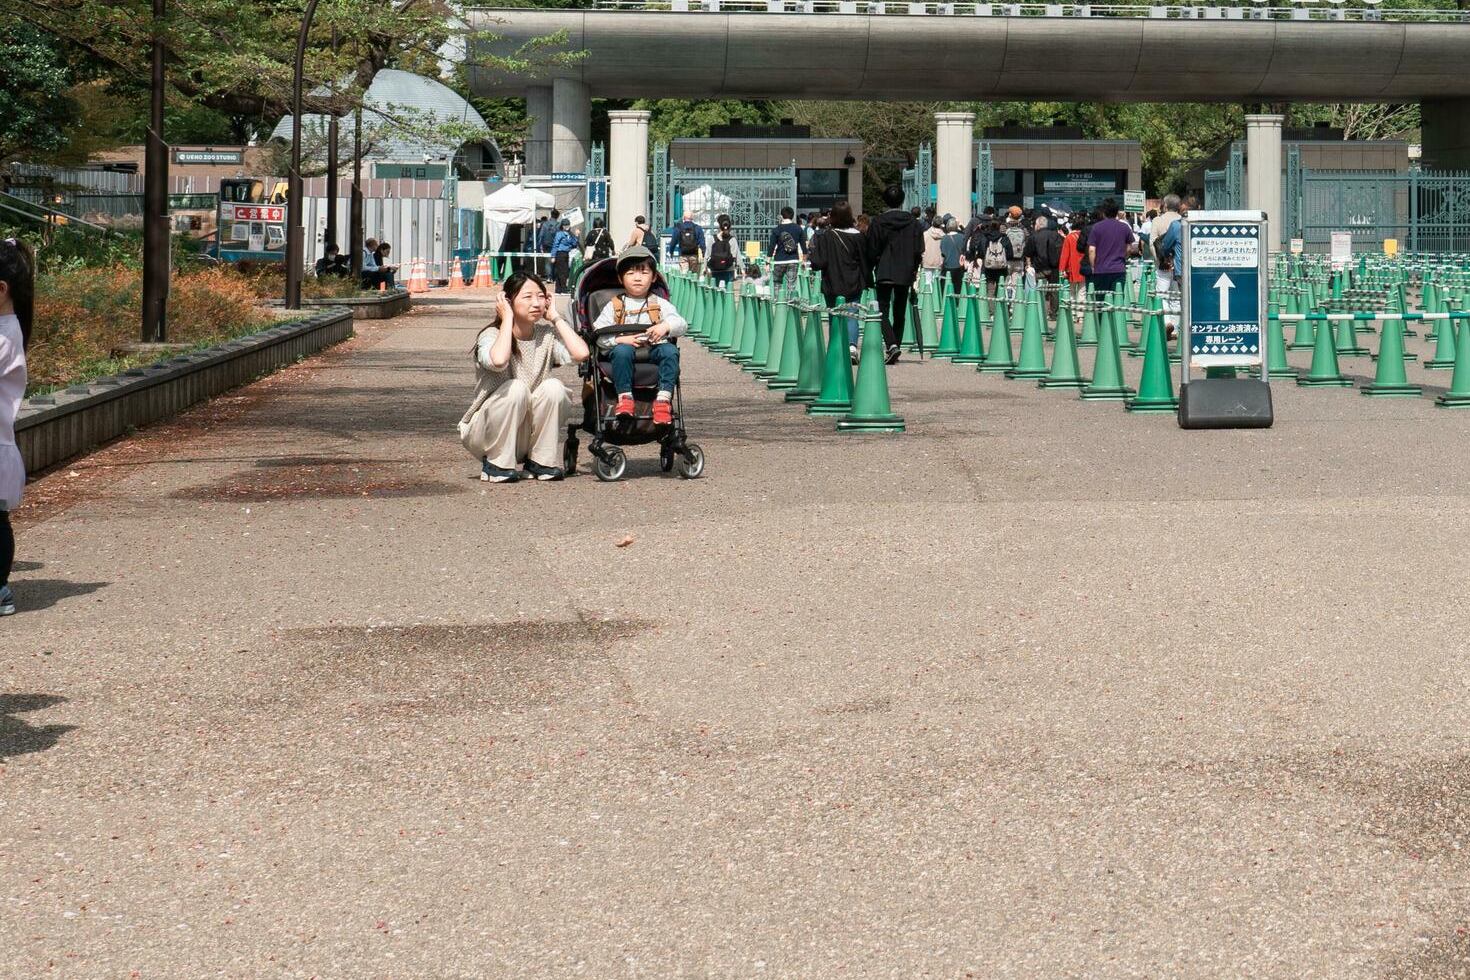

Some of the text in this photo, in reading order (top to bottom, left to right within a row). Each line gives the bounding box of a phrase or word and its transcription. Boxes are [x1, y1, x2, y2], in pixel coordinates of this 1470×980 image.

[401, 167, 426, 178] 出口
[1191, 323, 1258, 332] オンライン決済済み
[1205, 335, 1244, 343] 専用レーン
